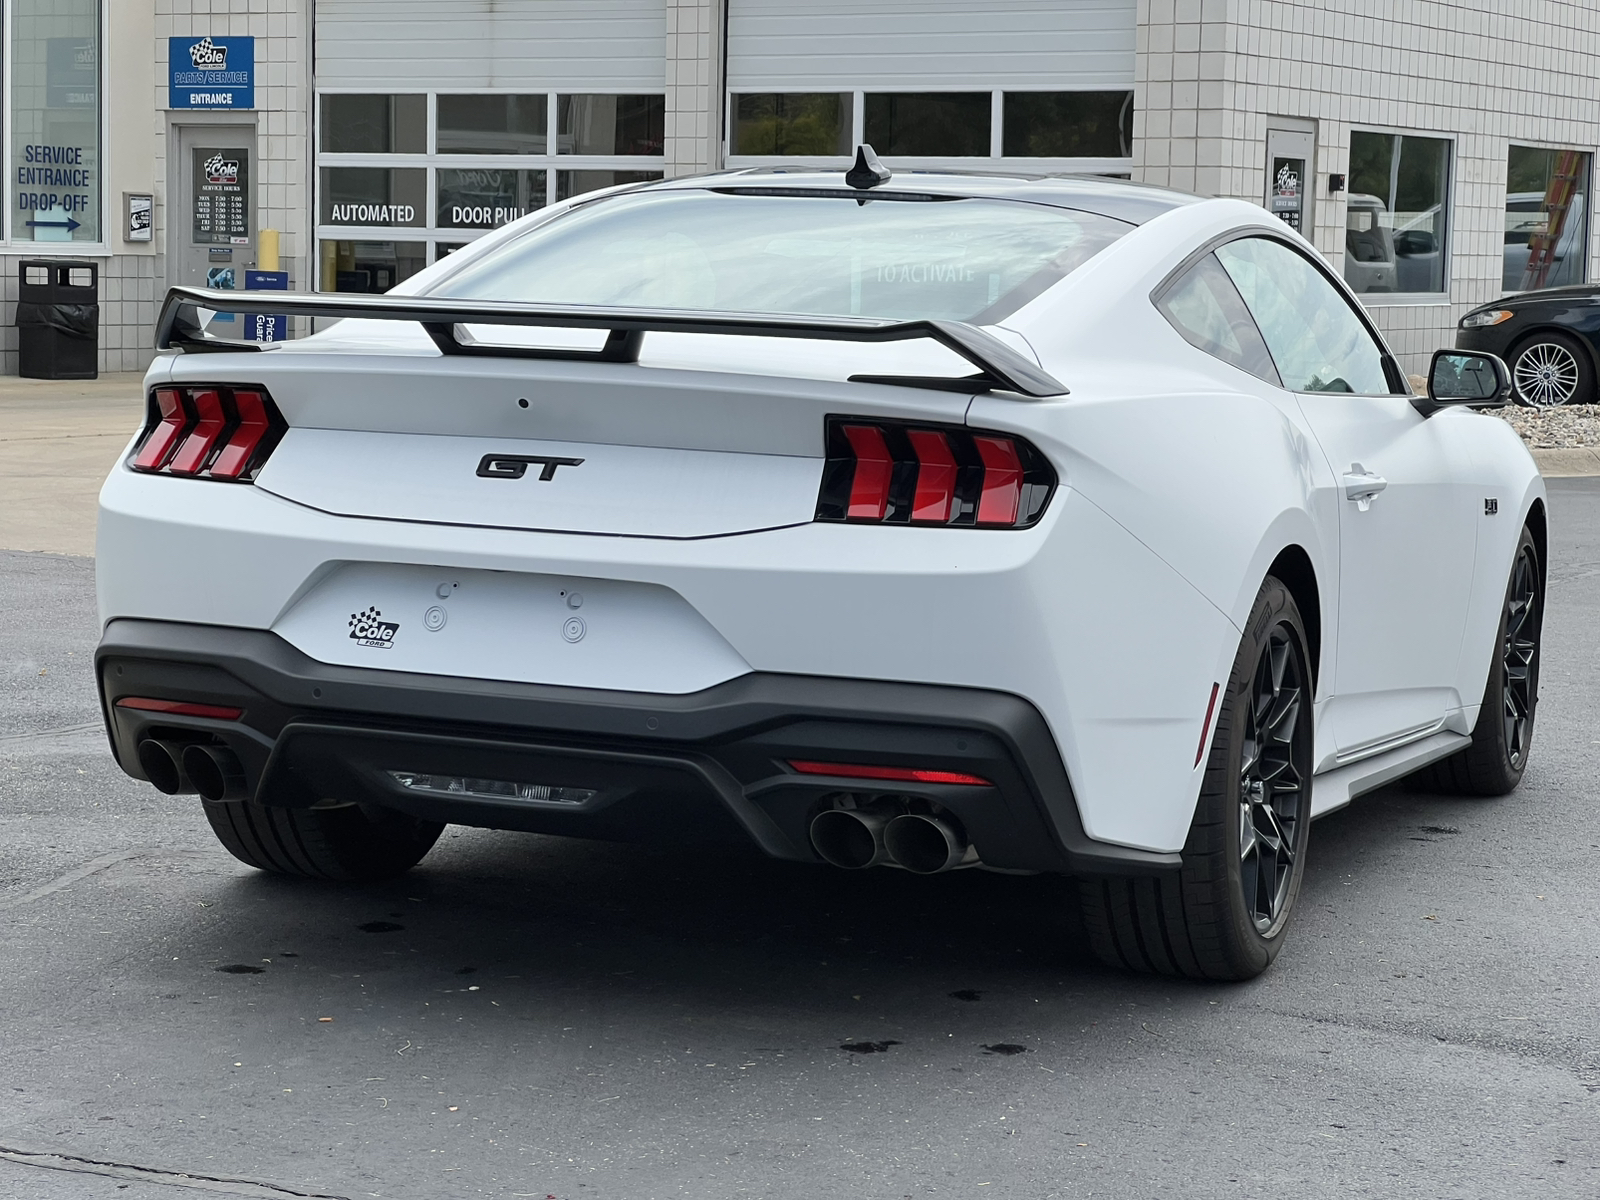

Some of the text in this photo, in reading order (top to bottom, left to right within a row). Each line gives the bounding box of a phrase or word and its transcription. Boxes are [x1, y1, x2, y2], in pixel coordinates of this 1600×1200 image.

[196, 50, 224, 63] Cole
[174, 71, 248, 84] PARTS/SERVICE
[190, 93, 233, 104] ENTRANCE
[25, 144, 82, 165] SERVICE
[18, 166, 89, 187] ENTRANCE
[211, 163, 238, 176] Cole
[1281, 174, 1297, 189] Cole
[19, 192, 89, 212] DROP-OFF
[331, 204, 415, 222] AUTOMATED
[452, 206, 492, 224] DOOR
[899, 263, 975, 283] ACTIVATE
[266, 317, 275, 342] Price
[475, 453, 586, 482] GT
[354, 622, 394, 641] Cole
